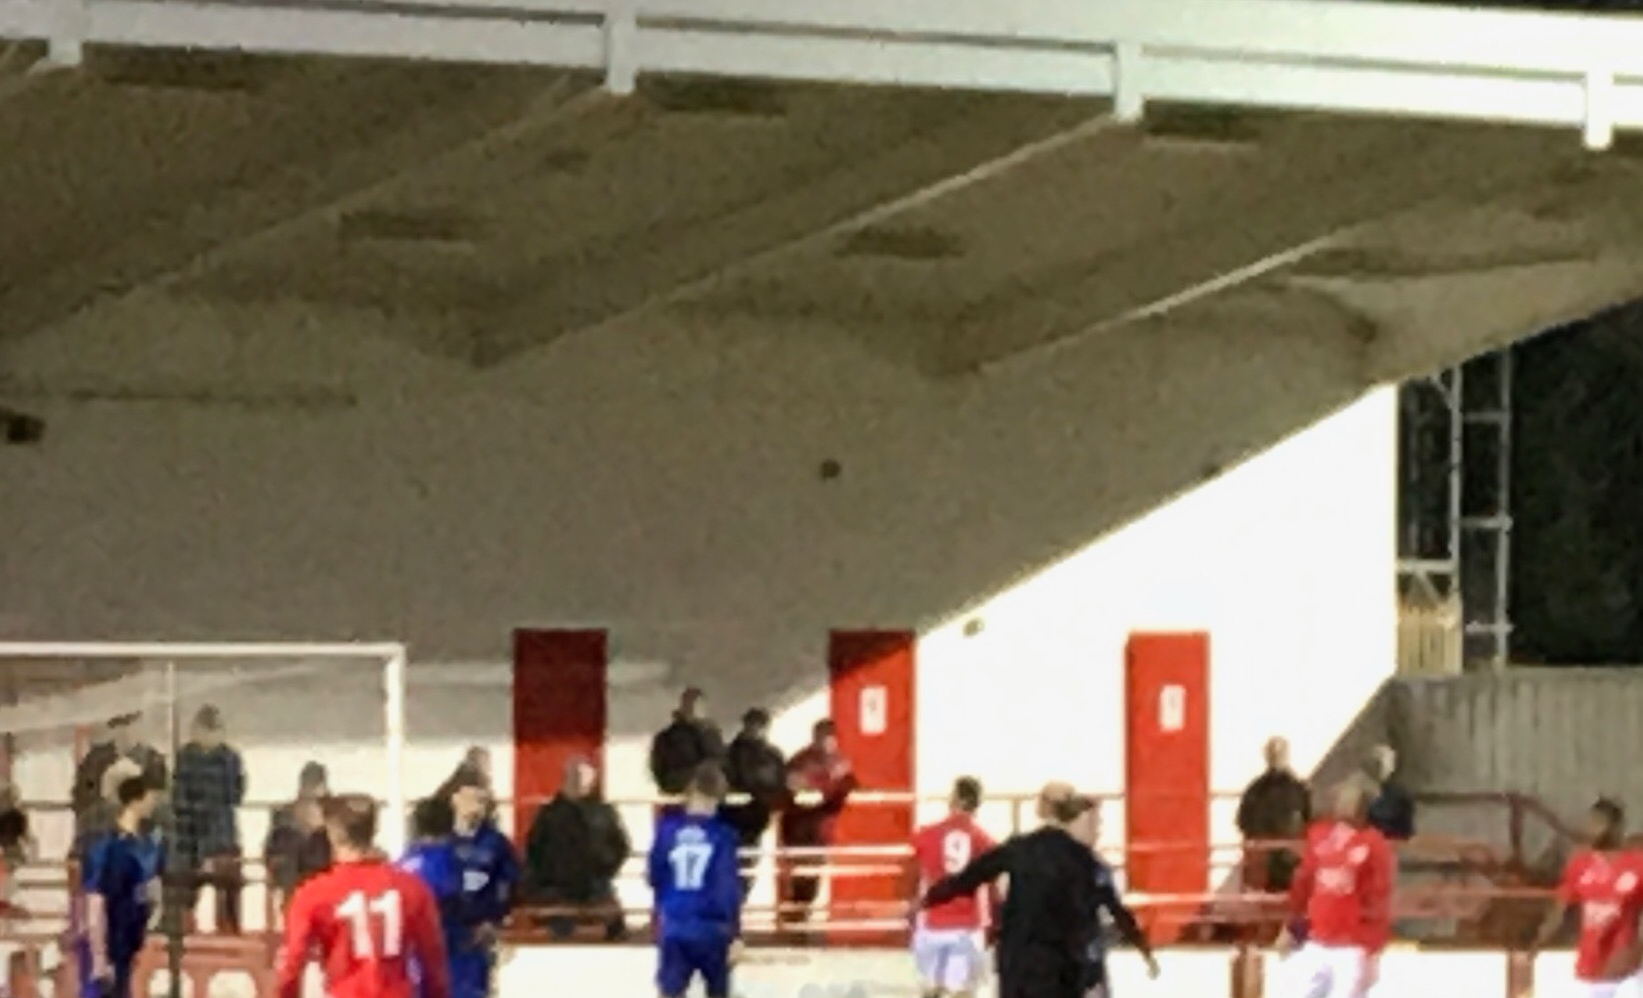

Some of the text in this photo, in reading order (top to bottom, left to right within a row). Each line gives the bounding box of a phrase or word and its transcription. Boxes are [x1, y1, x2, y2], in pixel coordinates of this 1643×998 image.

[668, 843, 713, 891] 17
[943, 829, 972, 875] 9
[334, 889, 402, 958] 11
